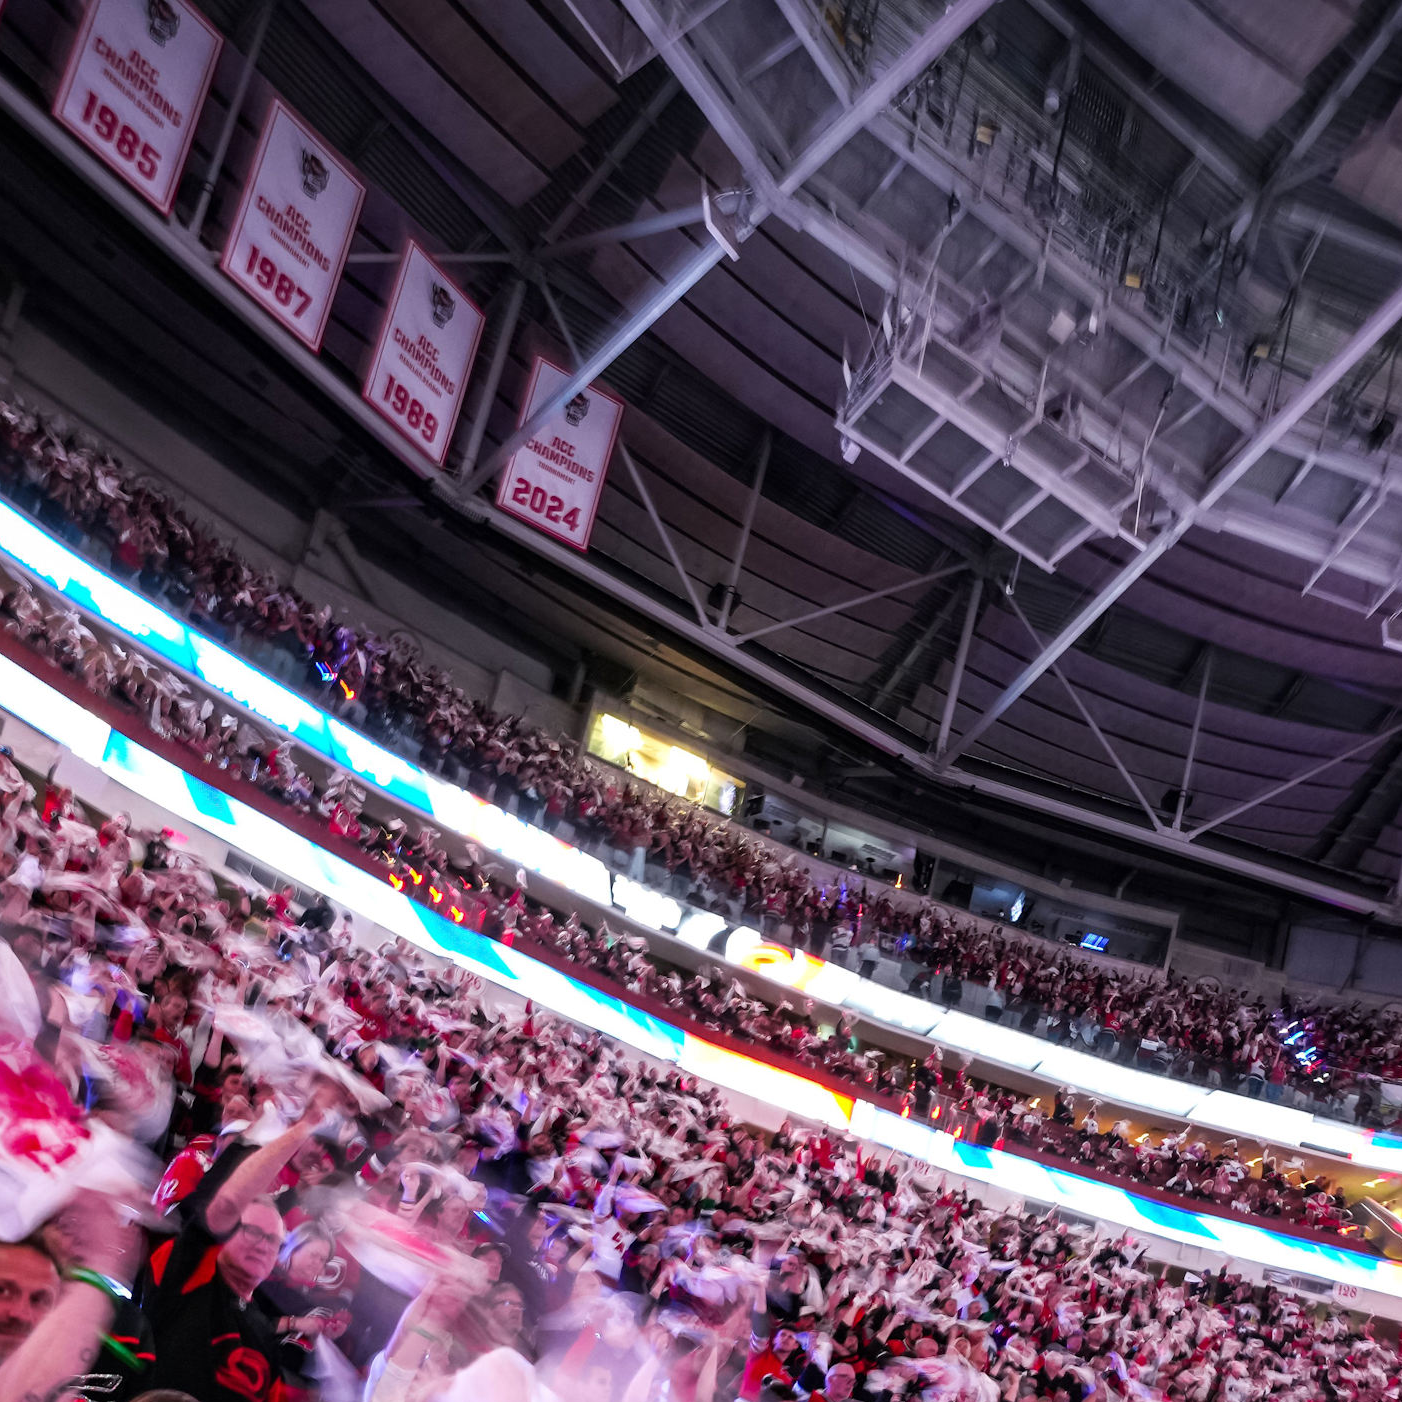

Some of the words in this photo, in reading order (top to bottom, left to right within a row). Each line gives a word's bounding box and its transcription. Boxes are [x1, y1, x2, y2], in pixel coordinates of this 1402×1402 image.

[92, 35, 183, 129] CHAMPIONS
[82, 88, 162, 182] 1985
[255, 194, 332, 273] CHAMPIONS
[284, 204, 313, 236] ACC
[246, 243, 313, 319] 1987
[392, 326, 457, 396] CHAMPIONS
[383, 371, 440, 444] 1989
[525, 438, 596, 483] CHAMPIONS
[551, 436, 577, 458] ACC
[511, 476, 583, 533] 2024
[1337, 1283, 1359, 1299] 128
